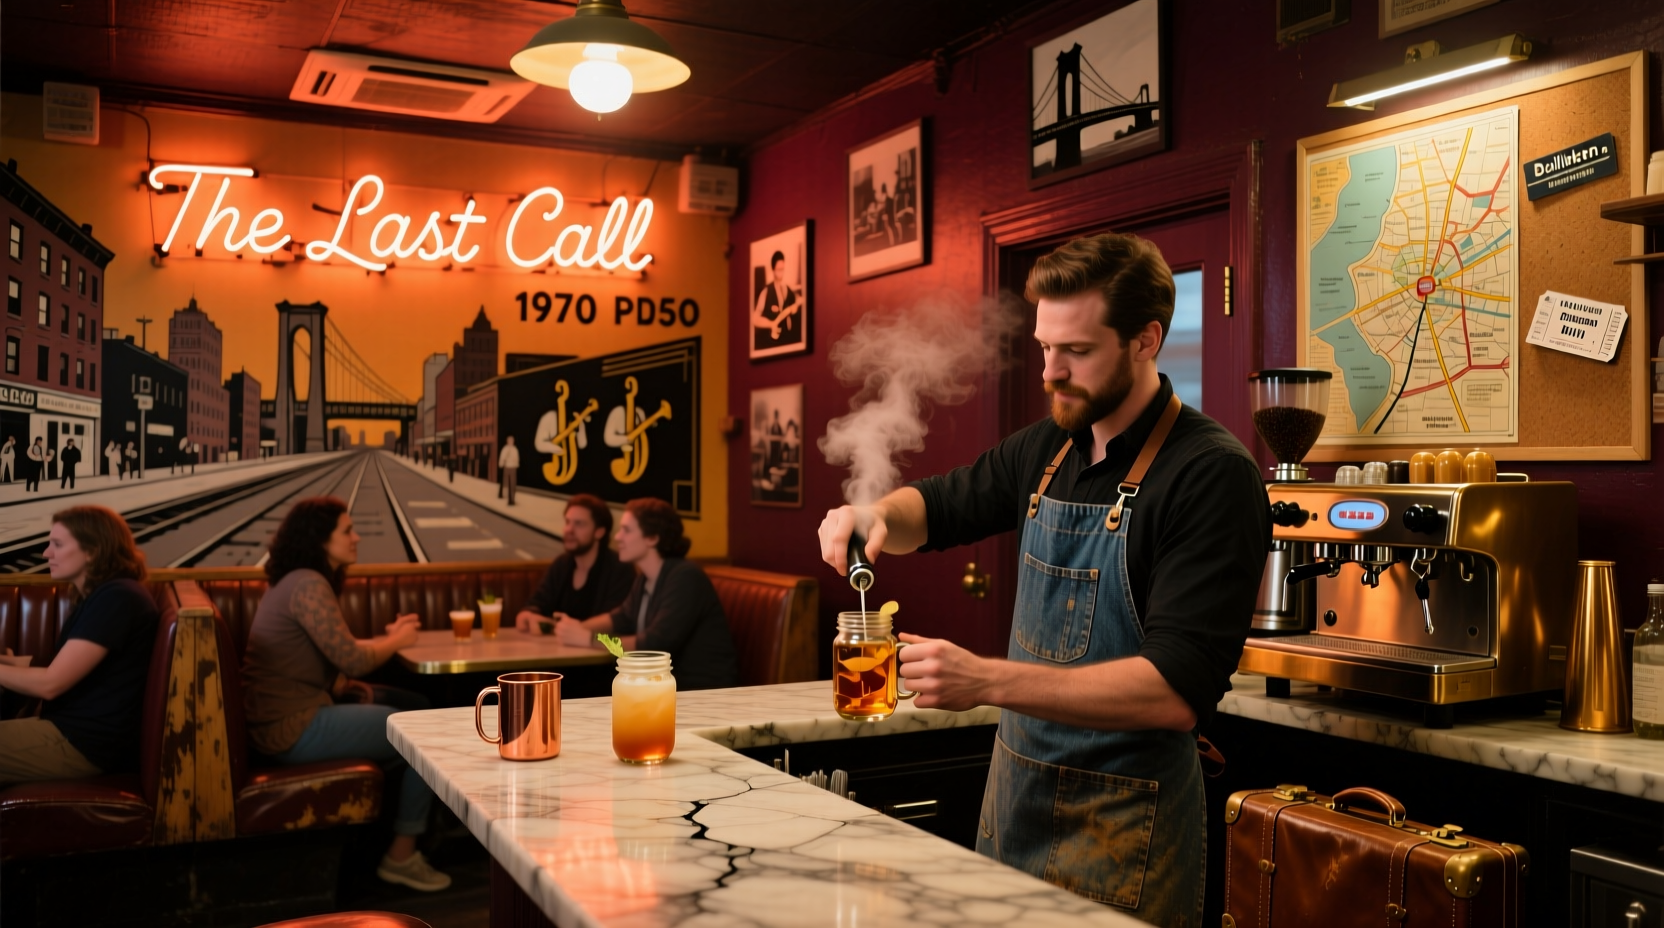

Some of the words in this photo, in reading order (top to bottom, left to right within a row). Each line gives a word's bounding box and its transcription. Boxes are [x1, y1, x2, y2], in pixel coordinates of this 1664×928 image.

[149, 164, 291, 254] The
[305, 174, 486, 271] Last
[505, 186, 654, 271] Call
[515, 291, 597, 325] 1970
[614, 296, 700, 327] PD50
